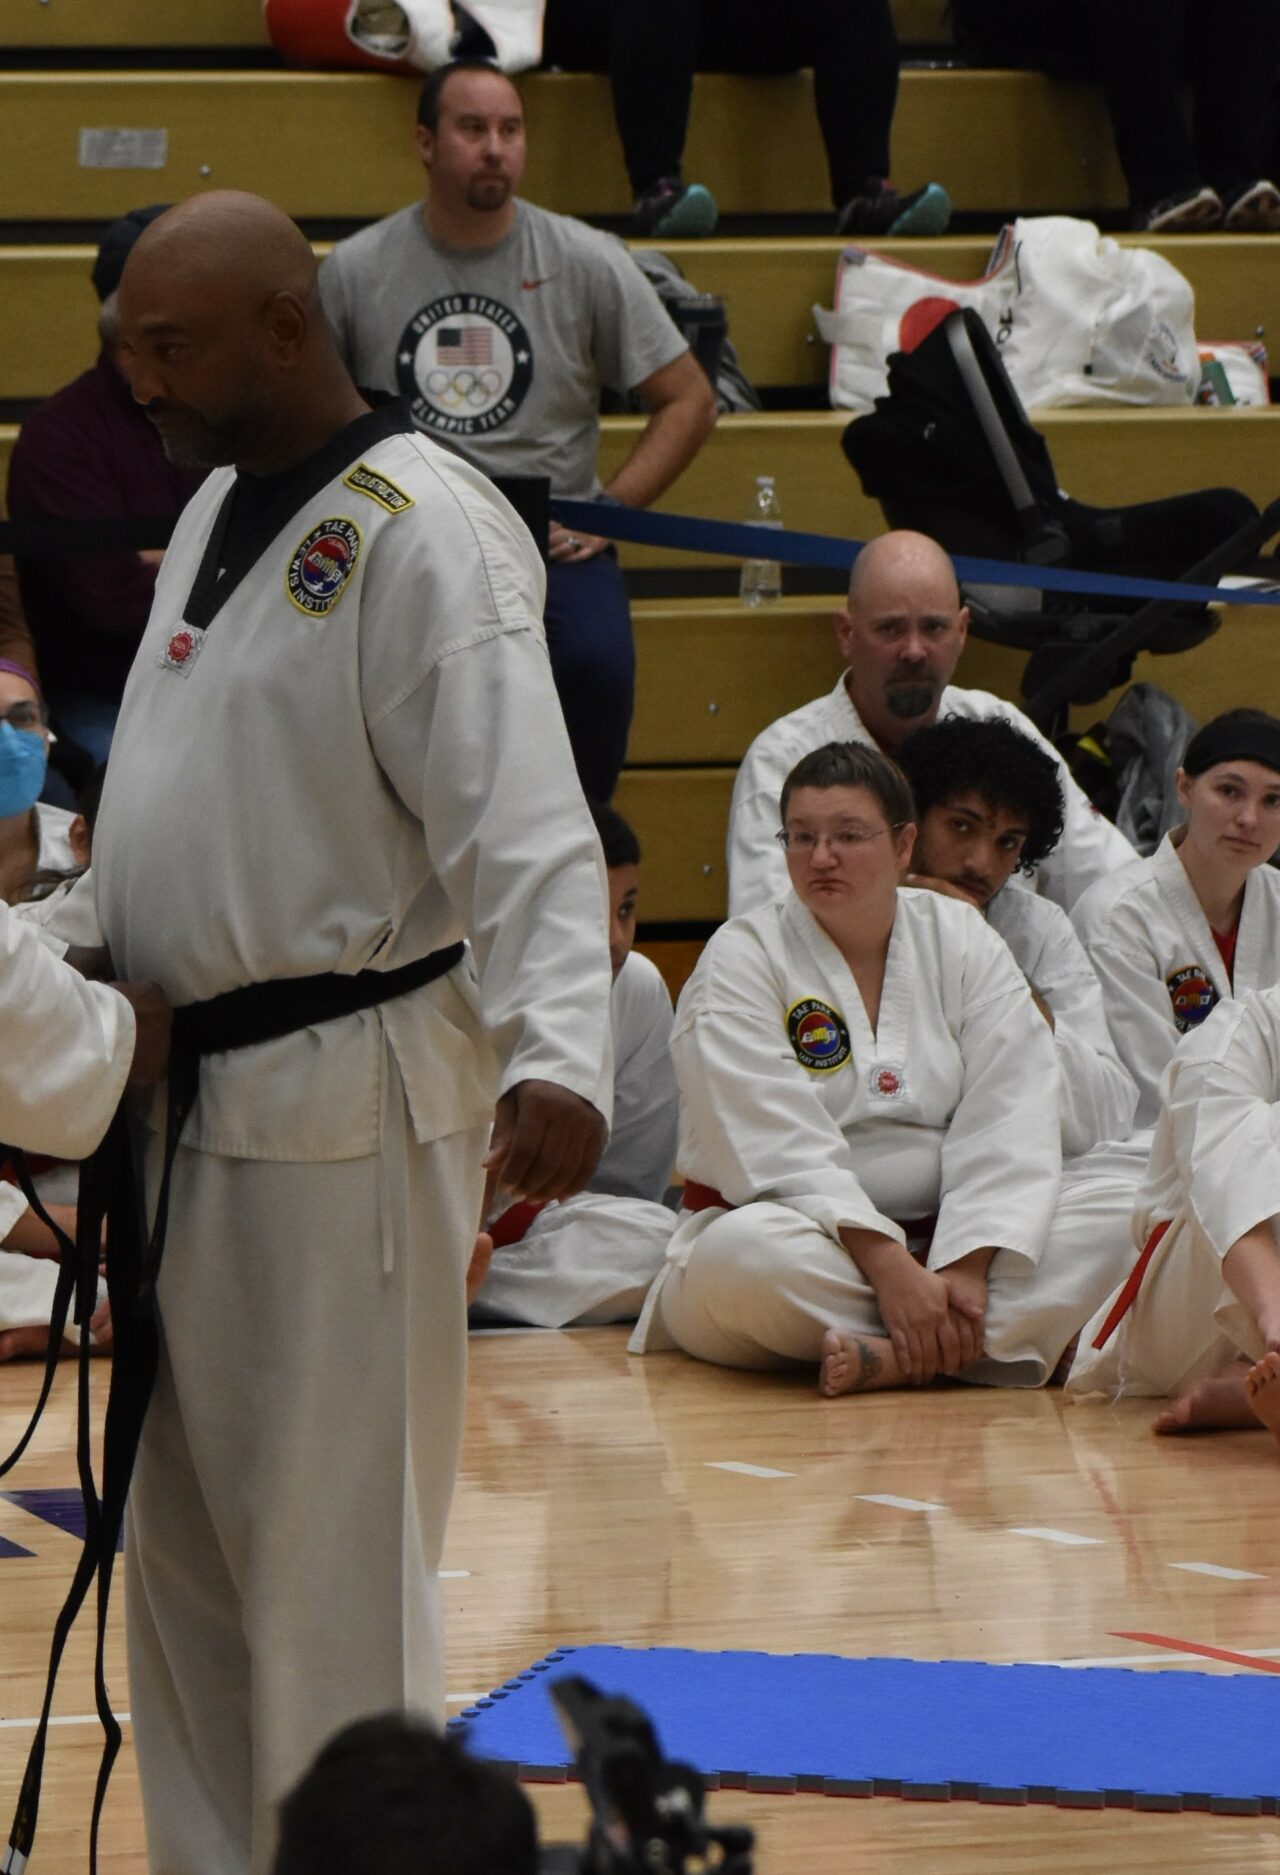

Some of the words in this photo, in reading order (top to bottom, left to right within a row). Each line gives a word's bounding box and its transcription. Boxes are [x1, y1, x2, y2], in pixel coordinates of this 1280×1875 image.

[412, 298, 462, 333] UNITED
[468, 297, 519, 333] STATES
[412, 398, 474, 432] OLYMPIC
[480, 398, 517, 429] TEAM
[324, 521, 346, 533] TAE
[792, 1003, 809, 1019] TAE
[811, 1001, 832, 1016] PARK
